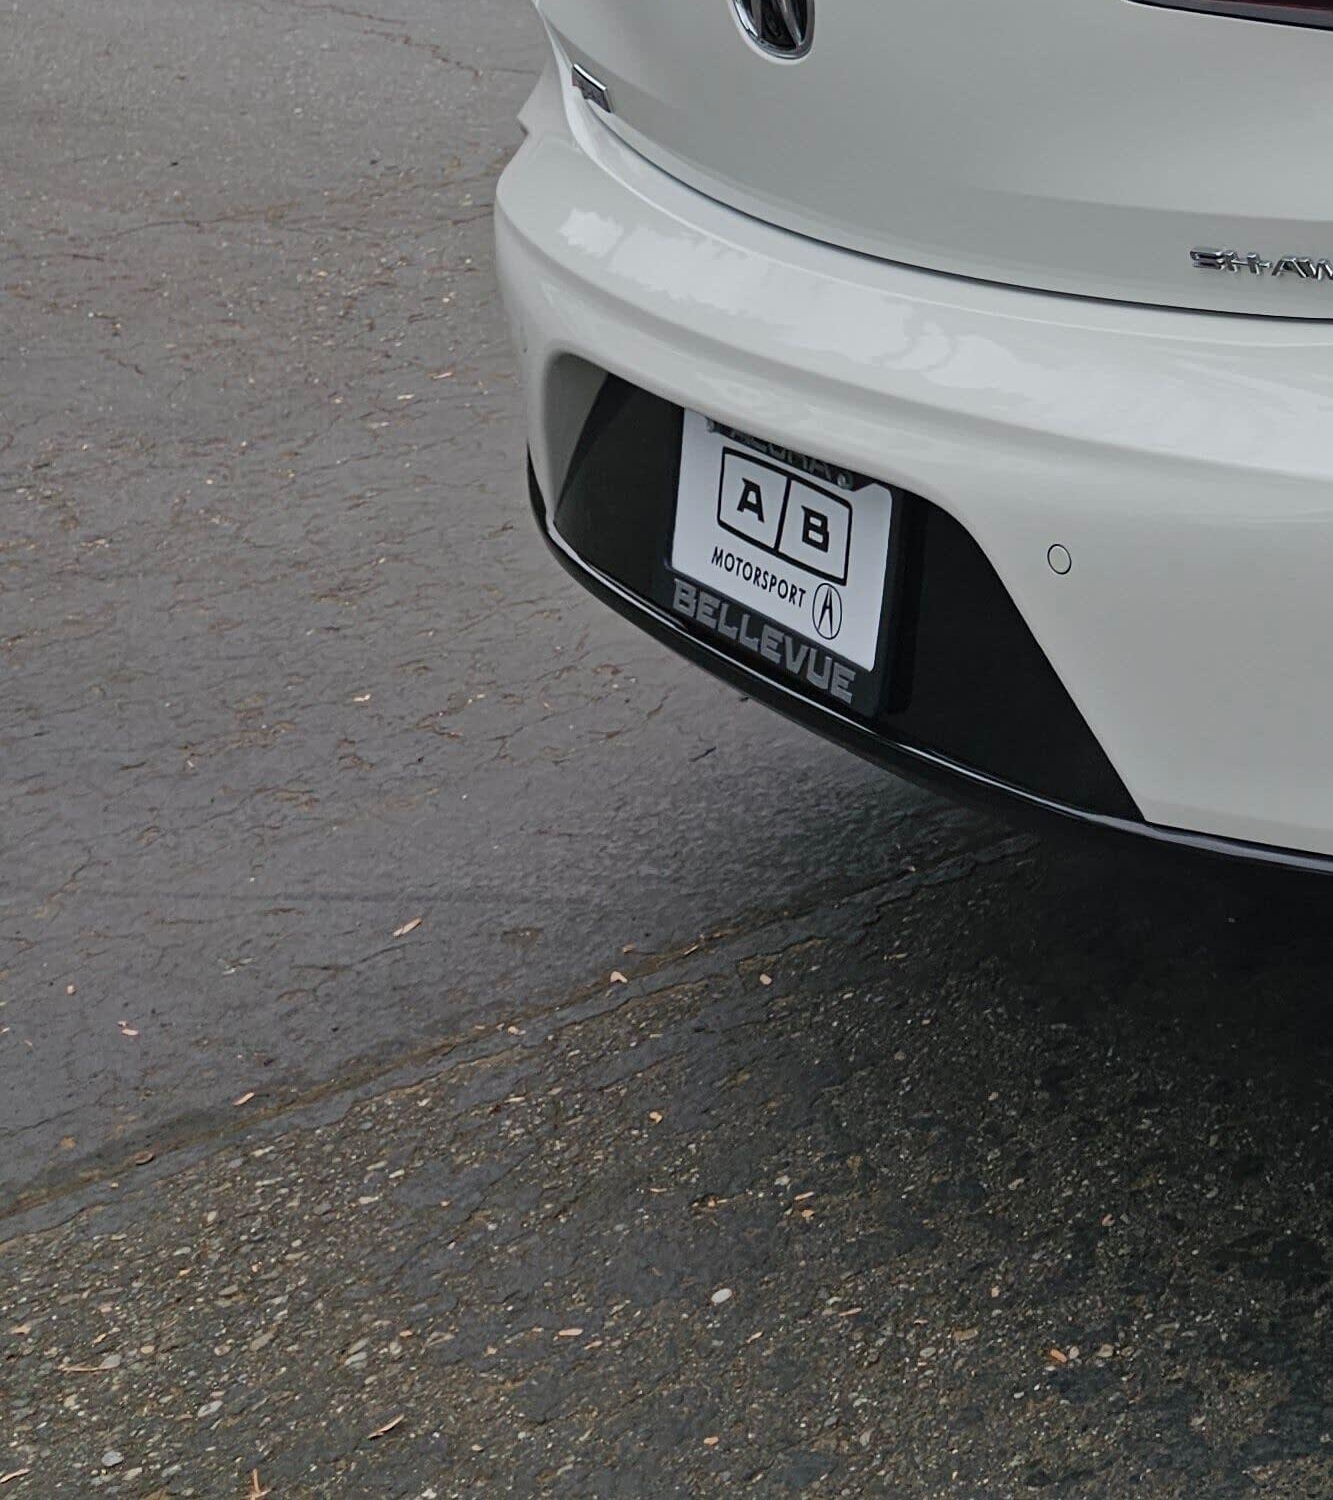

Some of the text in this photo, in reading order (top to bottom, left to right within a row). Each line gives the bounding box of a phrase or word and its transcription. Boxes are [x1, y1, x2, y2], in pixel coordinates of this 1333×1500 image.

[736, 477, 830, 553] A B
[711, 545, 807, 608] MOTORSPORT
[672, 577, 857, 702] BELLEVUE
